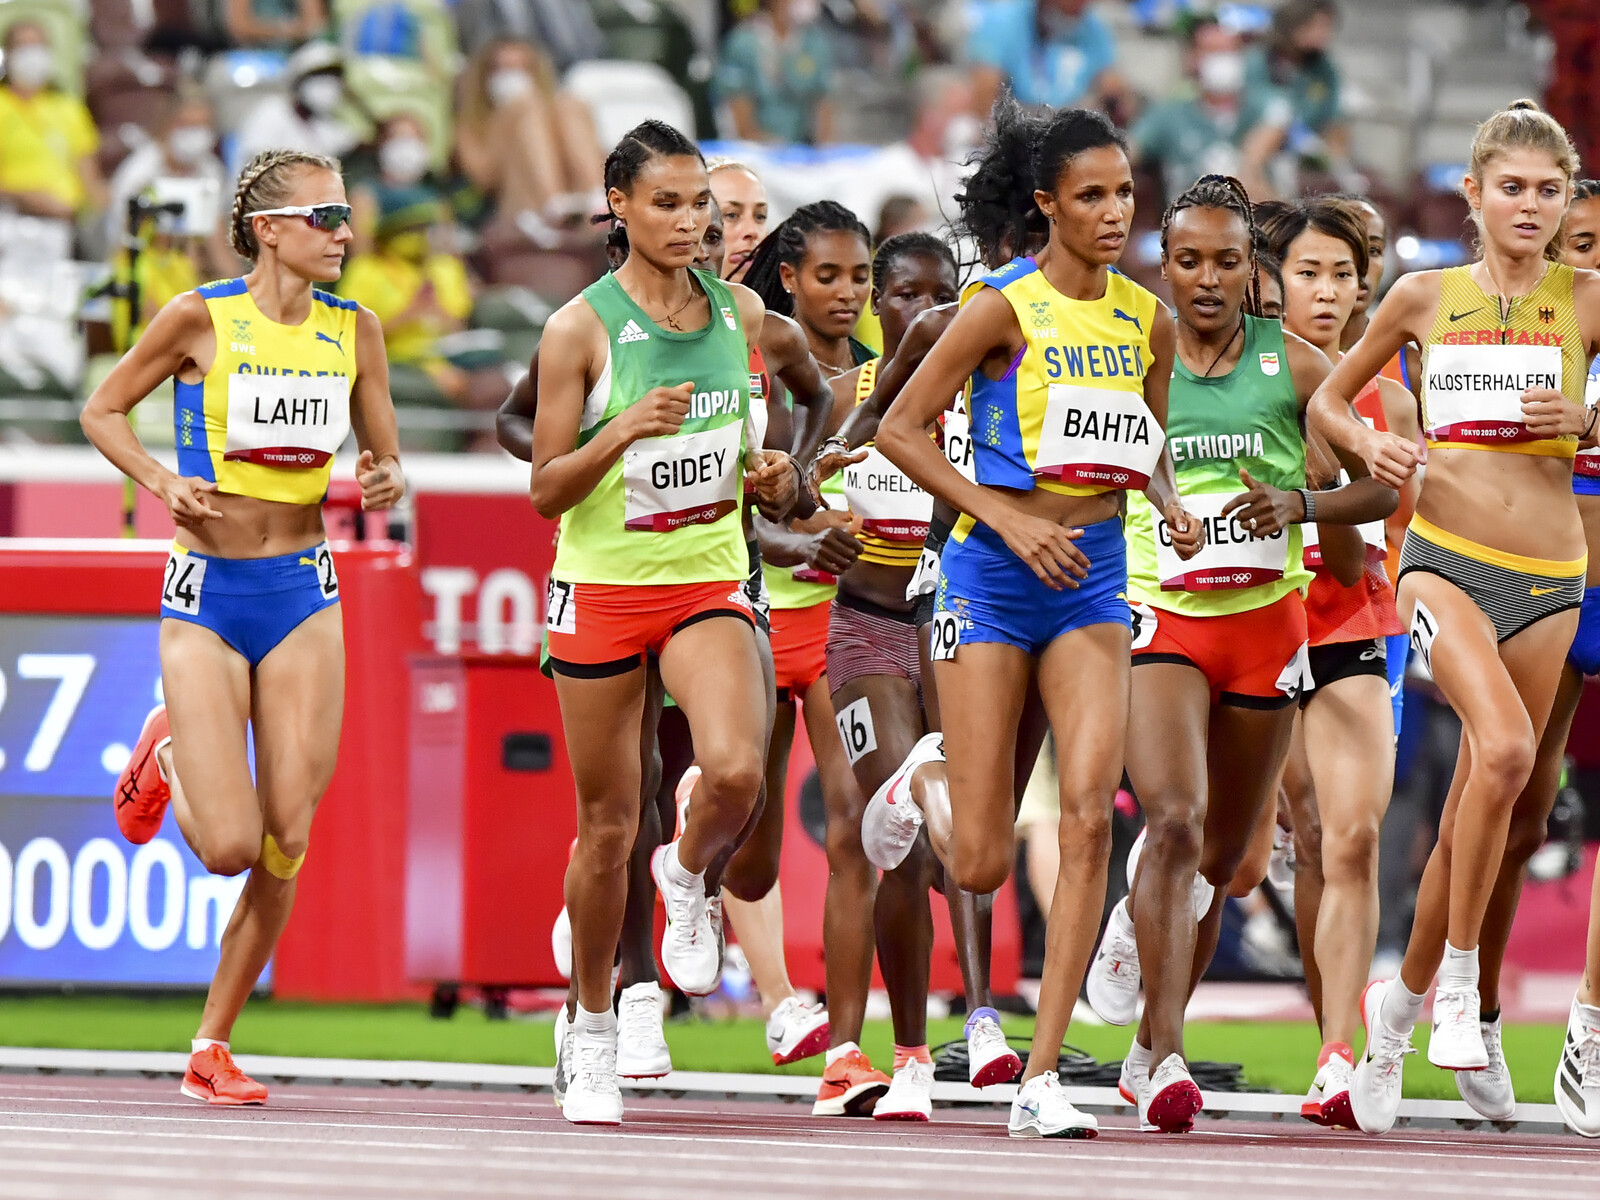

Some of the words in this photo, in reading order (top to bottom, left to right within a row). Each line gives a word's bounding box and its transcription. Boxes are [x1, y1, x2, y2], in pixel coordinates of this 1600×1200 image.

[617, 332, 650, 344] adidas
[1032, 328, 1058, 339] SWE
[230, 342, 256, 355] SWE
[1044, 344, 1145, 378] SWEDEN
[253, 396, 328, 425] LAHTI
[1063, 408, 1149, 446] BAHTA
[1461, 428, 1480, 436] TOKYO
[1481, 428, 1497, 436] 2020
[263, 453, 283, 461] TOKYO
[284, 454, 297, 462] 2020
[1170, 432, 1264, 462] ETHIOPIA
[651, 448, 726, 489] GIDEY
[1075, 470, 1096, 479] TOKYO
[1096, 471, 1111, 480] 2020
[847, 471, 861, 489] M.
[868, 474, 925, 493] CHELA
[894, 527, 909, 535] 2020
[164, 557, 196, 608] 24
[840, 708, 867, 760] 16
